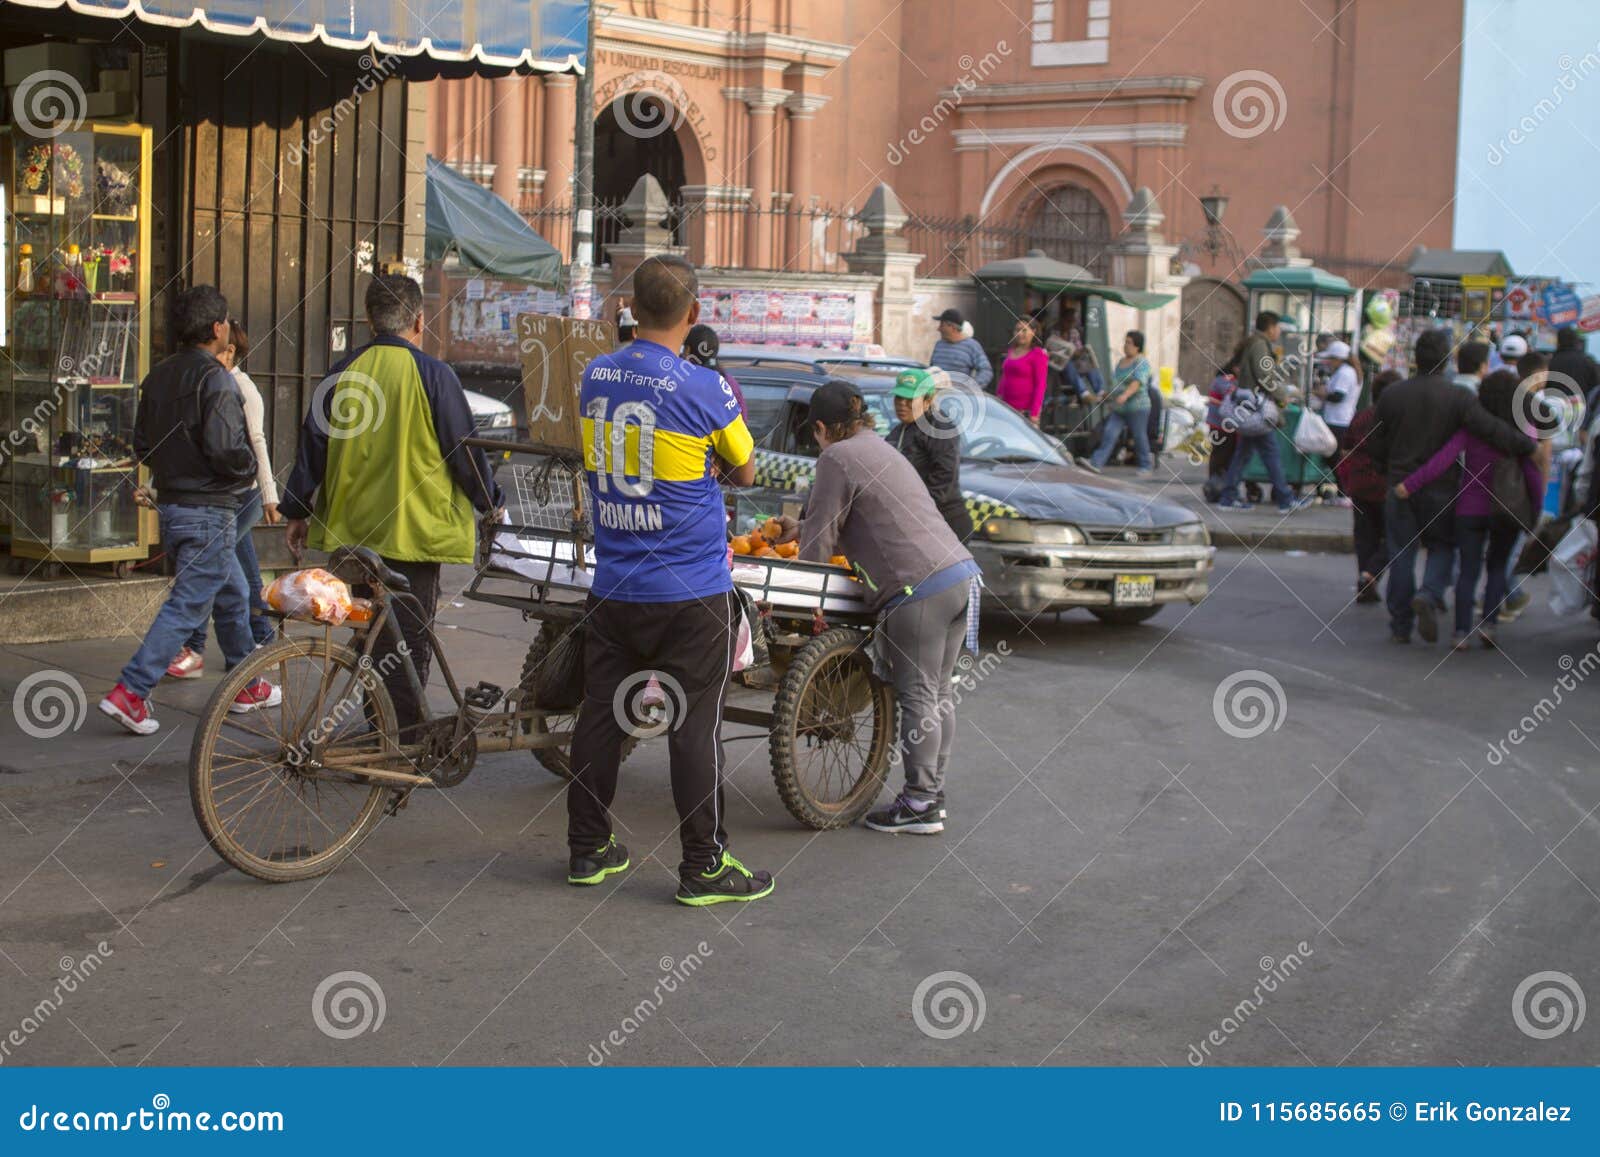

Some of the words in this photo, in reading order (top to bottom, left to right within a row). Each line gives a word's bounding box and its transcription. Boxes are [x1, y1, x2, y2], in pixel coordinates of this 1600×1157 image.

[522, 316, 547, 335] SIN
[520, 338, 563, 422] 2
[591, 367, 622, 383] BBVA
[587, 396, 657, 497] 10
[598, 500, 663, 531] ROMAN
